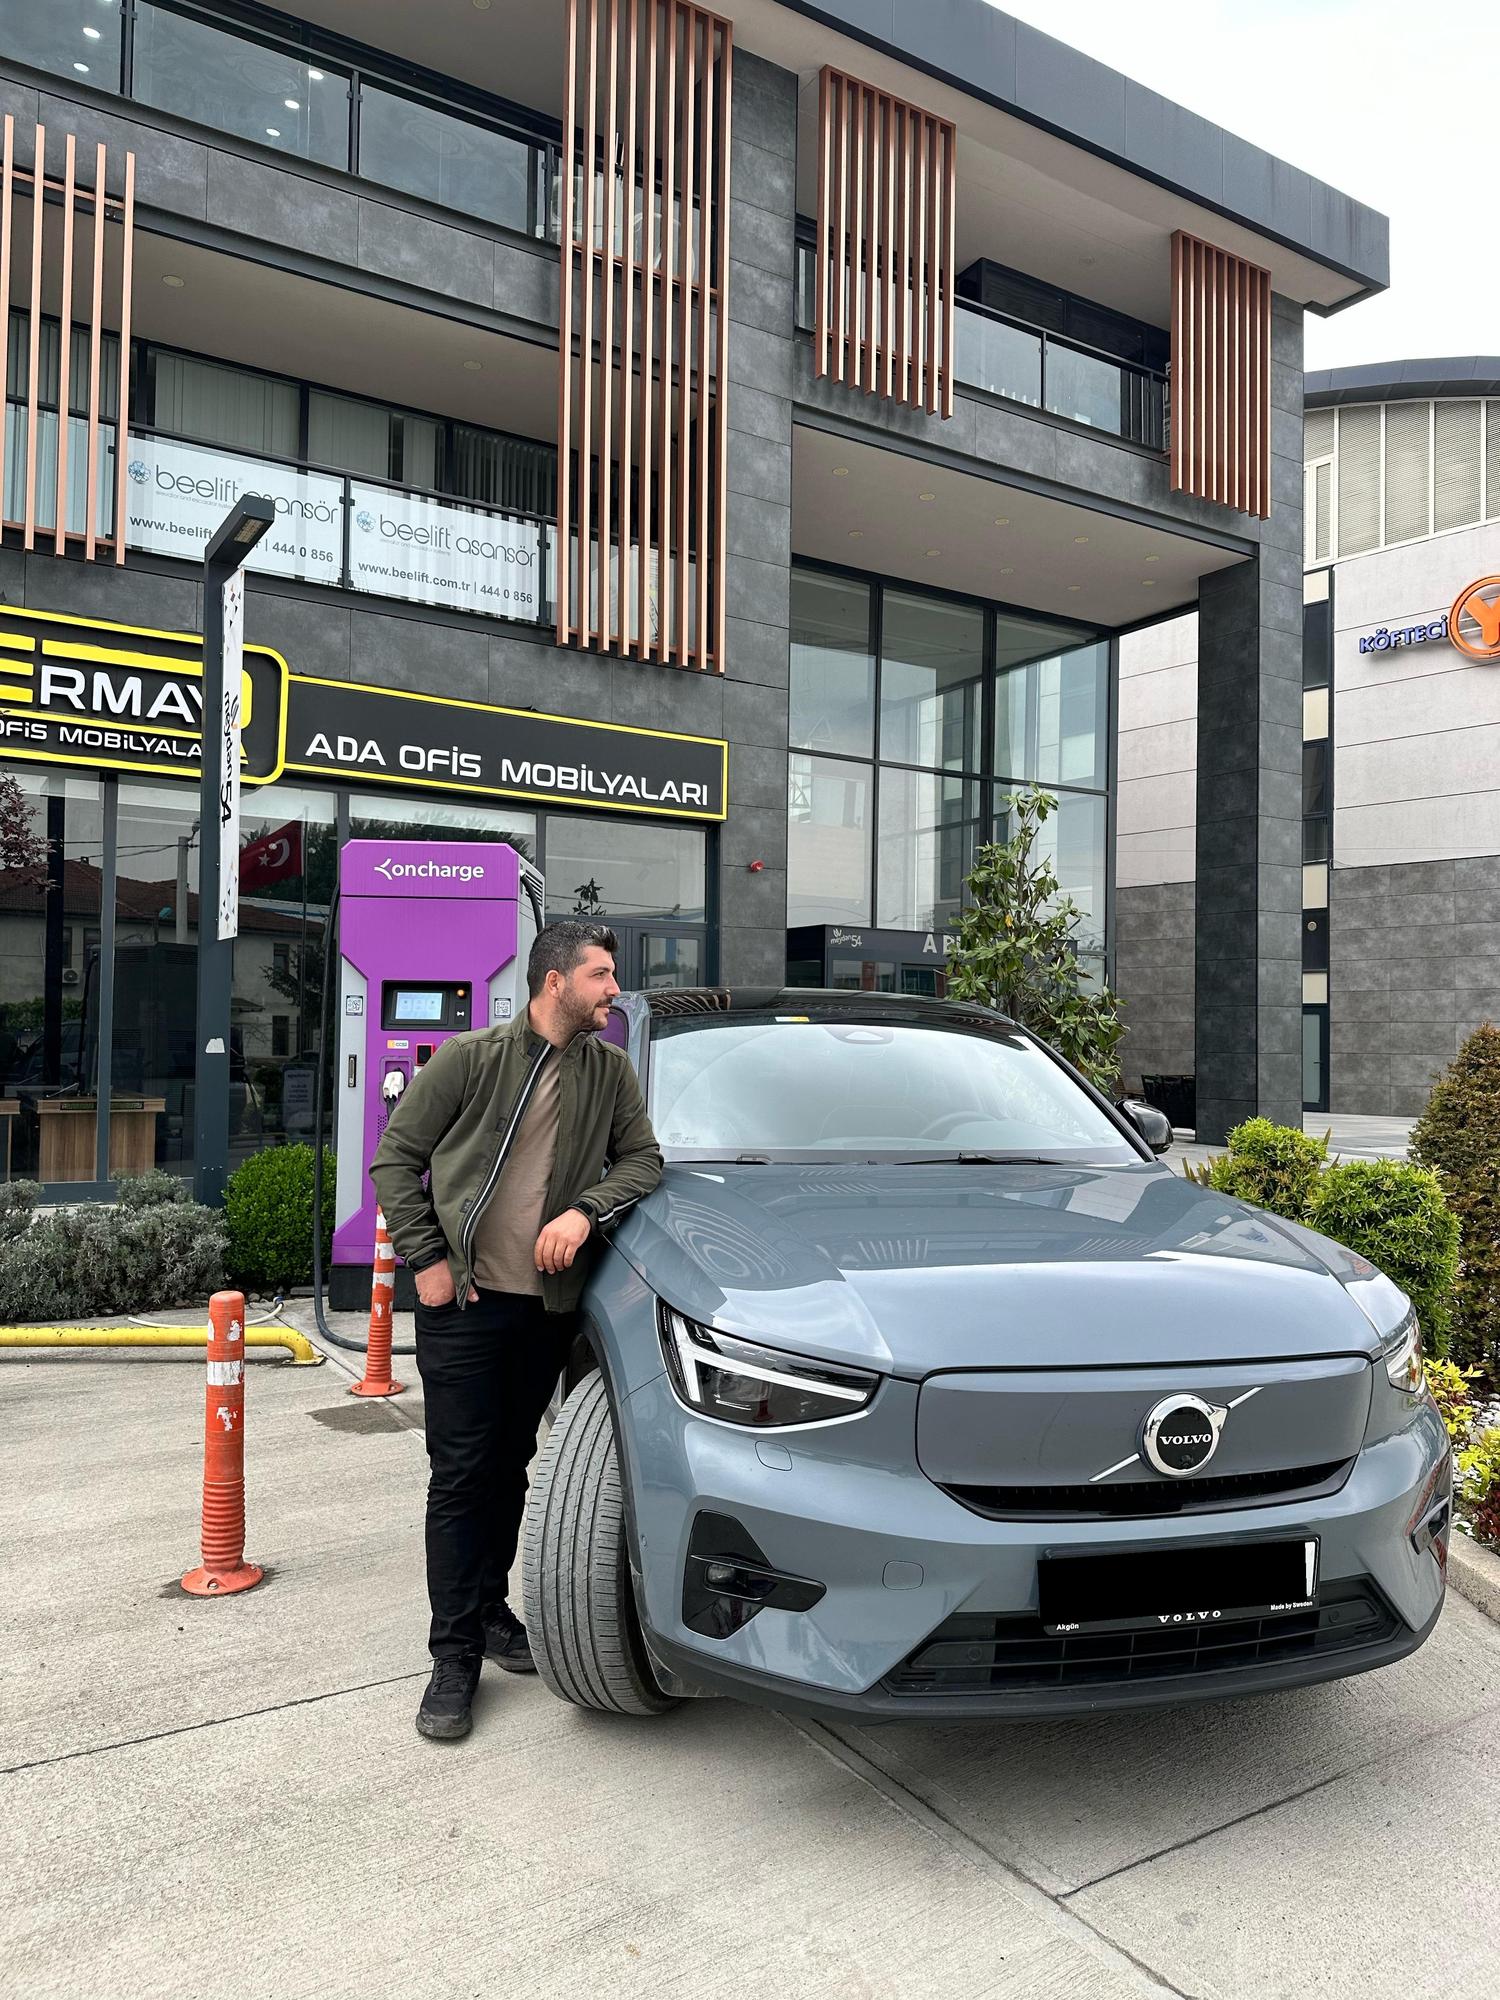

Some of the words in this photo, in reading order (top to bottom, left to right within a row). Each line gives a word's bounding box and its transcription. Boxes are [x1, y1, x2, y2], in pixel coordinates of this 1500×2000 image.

[156, 464, 239, 504] beelift
[272, 541, 296, 556] 444
[299, 547, 308, 558] 0
[311, 549, 334, 563] 856
[380, 513, 452, 550] beelift
[456, 537, 536, 568] asansör
[358, 562, 471, 592] www.beelift.com.tr
[480, 584, 501, 597] 444
[503, 589, 511, 600] 0
[513, 591, 533, 604] 856
[1360, 615, 1448, 653] KÖFTECİ
[0, 718, 48, 741] FiS
[304, 732, 387, 767] ADA
[399, 745, 482, 778] OFİS
[501, 758, 708, 806] MOBİLYALARI
[391, 861, 485, 882] oncharge
[1160, 1434, 1212, 1445] VOLVO
[1158, 1610, 1222, 1624] VOLVO
[1270, 1603, 1285, 1611] Made
